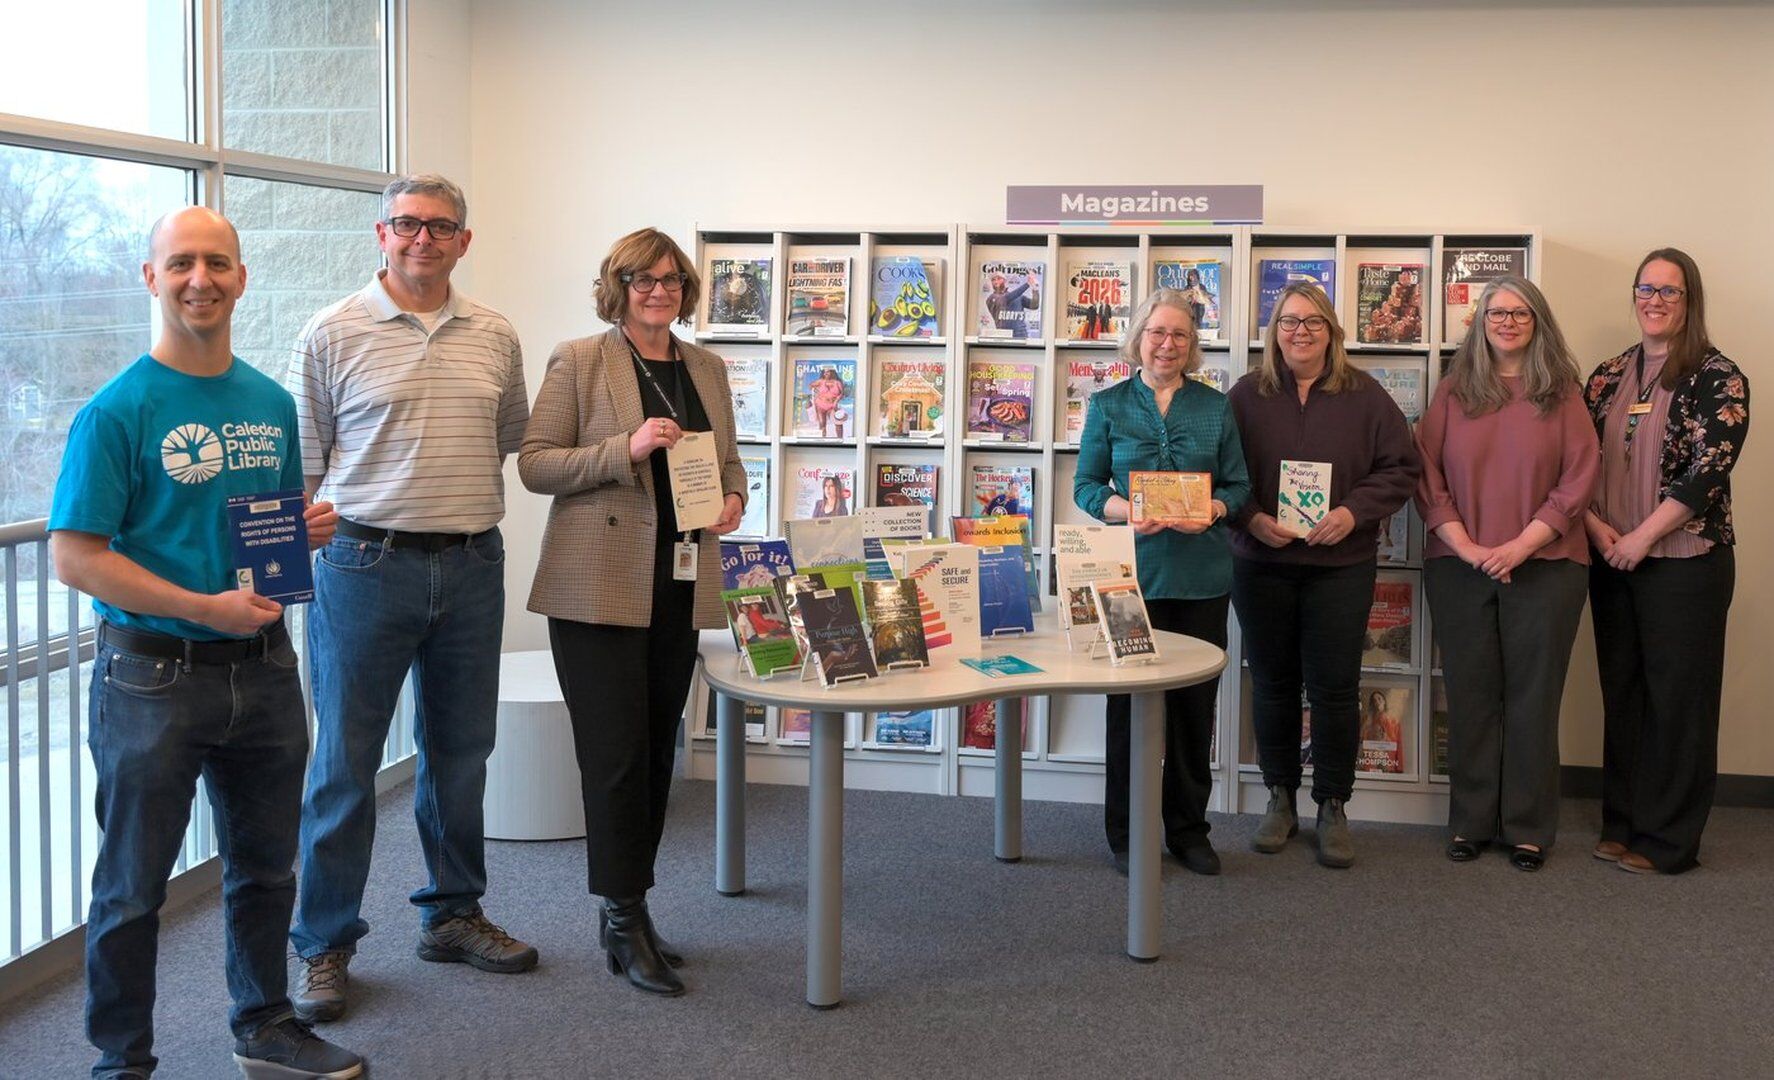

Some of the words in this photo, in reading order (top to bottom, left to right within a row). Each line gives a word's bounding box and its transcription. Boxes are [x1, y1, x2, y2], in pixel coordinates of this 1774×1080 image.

[1060, 191, 1209, 218] Magazines
[714, 262, 745, 274] alive
[792, 263, 808, 273] CAR
[816, 262, 845, 273] DRIVER
[982, 264, 1006, 274] Golf
[1483, 263, 1509, 271] MAIL
[1080, 270, 1120, 278] MACLEAN'S
[1361, 267, 1390, 278] Taste
[789, 279, 827, 287] LIGHTNING
[828, 278, 848, 287] FAS
[1078, 278, 1121, 305] 2026
[796, 365, 855, 373] CHATAINE
[1002, 388, 1030, 397] Spring
[222, 422, 282, 438] Caledon
[225, 437, 276, 454] Public
[228, 454, 281, 471] Library
[884, 473, 932, 482] DISCOVER
[976, 473, 987, 482] The
[901, 487, 932, 498] SCIENCE
[239, 518, 275, 528] CONVENTION
[883, 518, 922, 526] COLLECTION
[241, 529, 261, 538] RIGHTS
[271, 525, 297, 534] PERSONS
[963, 527, 991, 536] owards
[260, 535, 295, 545] DISABILITIES
[1060, 546, 1074, 554] and
[1075, 544, 1091, 554] able
[720, 556, 739, 571] Go
[741, 550, 765, 566] for
[768, 551, 788, 565] it!
[941, 567, 959, 576] SAFE
[941, 575, 969, 585] SECURE
[1121, 644, 1149, 653] HUMAN
[1363, 751, 1390, 759] TESSA
[1356, 758, 1399, 766] HOMPSON
